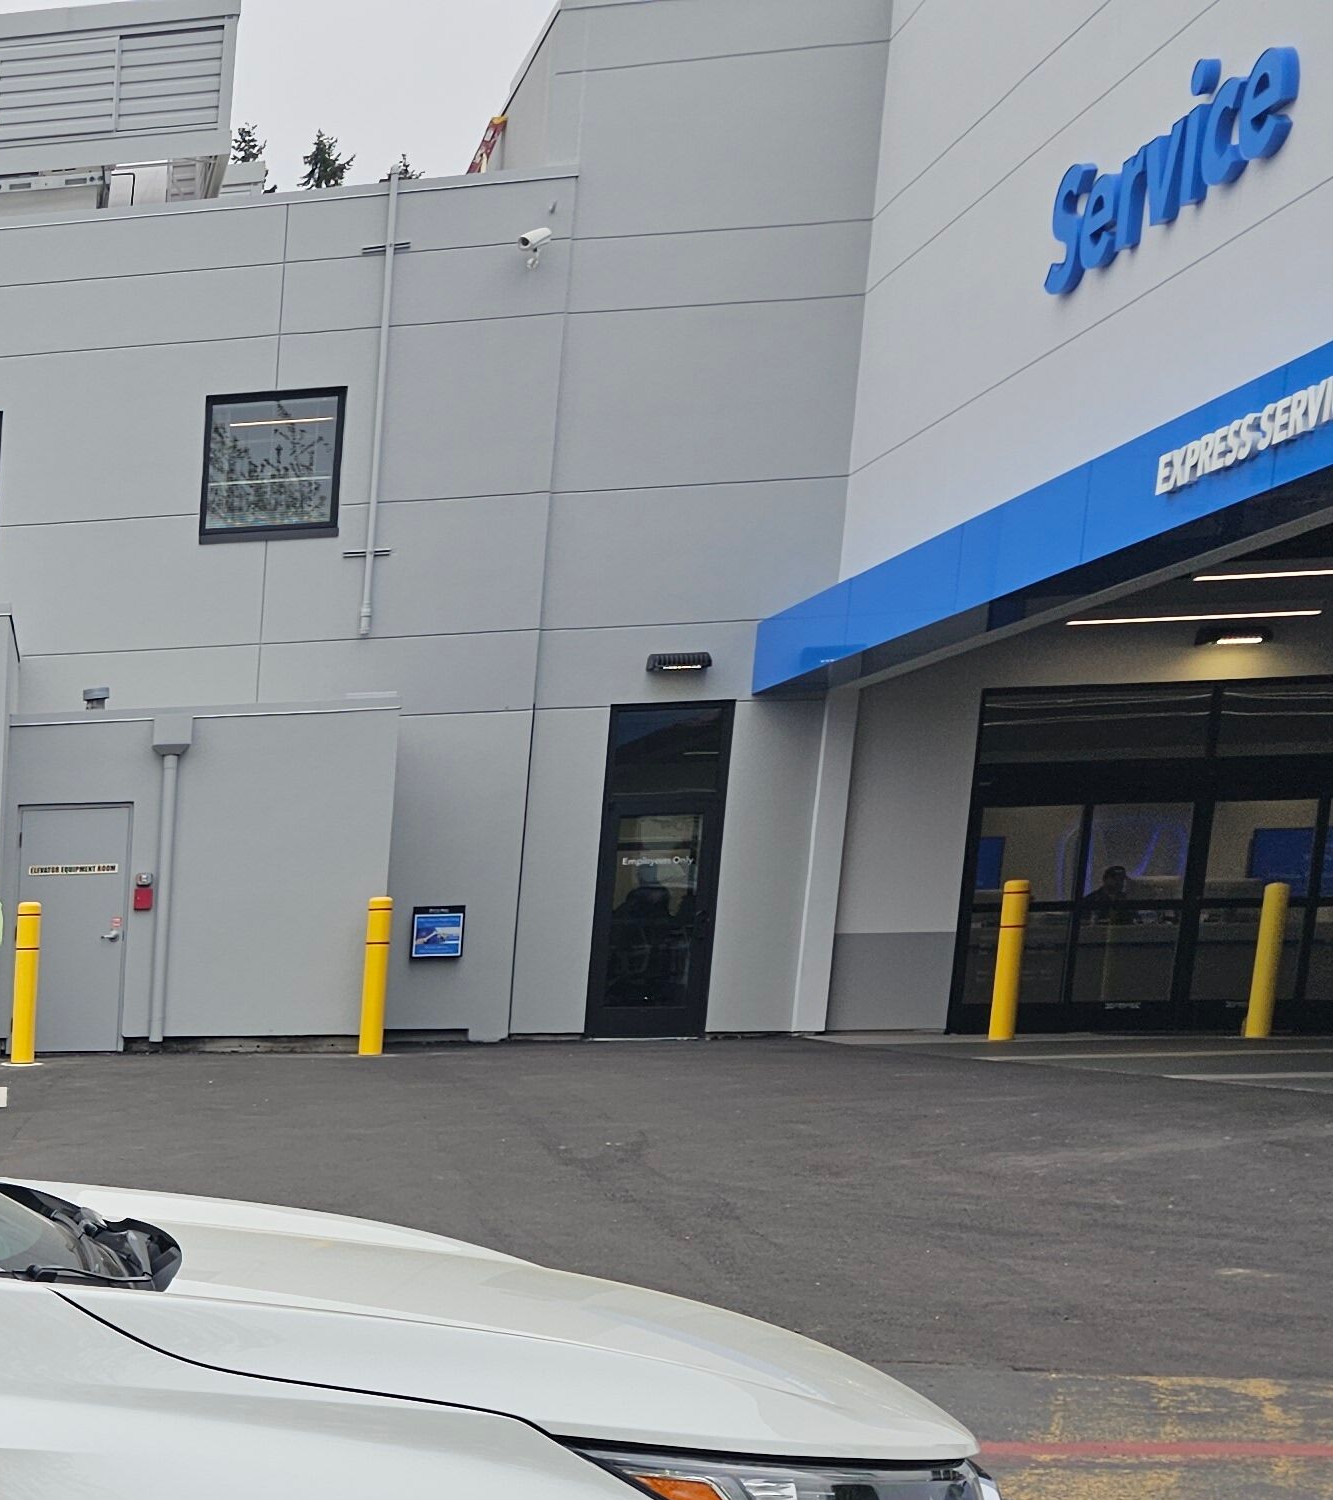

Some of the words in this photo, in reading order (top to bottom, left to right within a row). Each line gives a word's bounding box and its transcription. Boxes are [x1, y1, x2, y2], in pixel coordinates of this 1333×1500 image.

[1044, 46, 1300, 296] Service
[1154, 412, 1263, 496] EXPRESS
[1257, 375, 1333, 451] SERVI
[30, 866, 59, 874] ELEVATOR
[61, 865, 96, 873] EQUIPMENT
[97, 864, 116, 872] ROOM
[673, 855, 694, 866] Only
